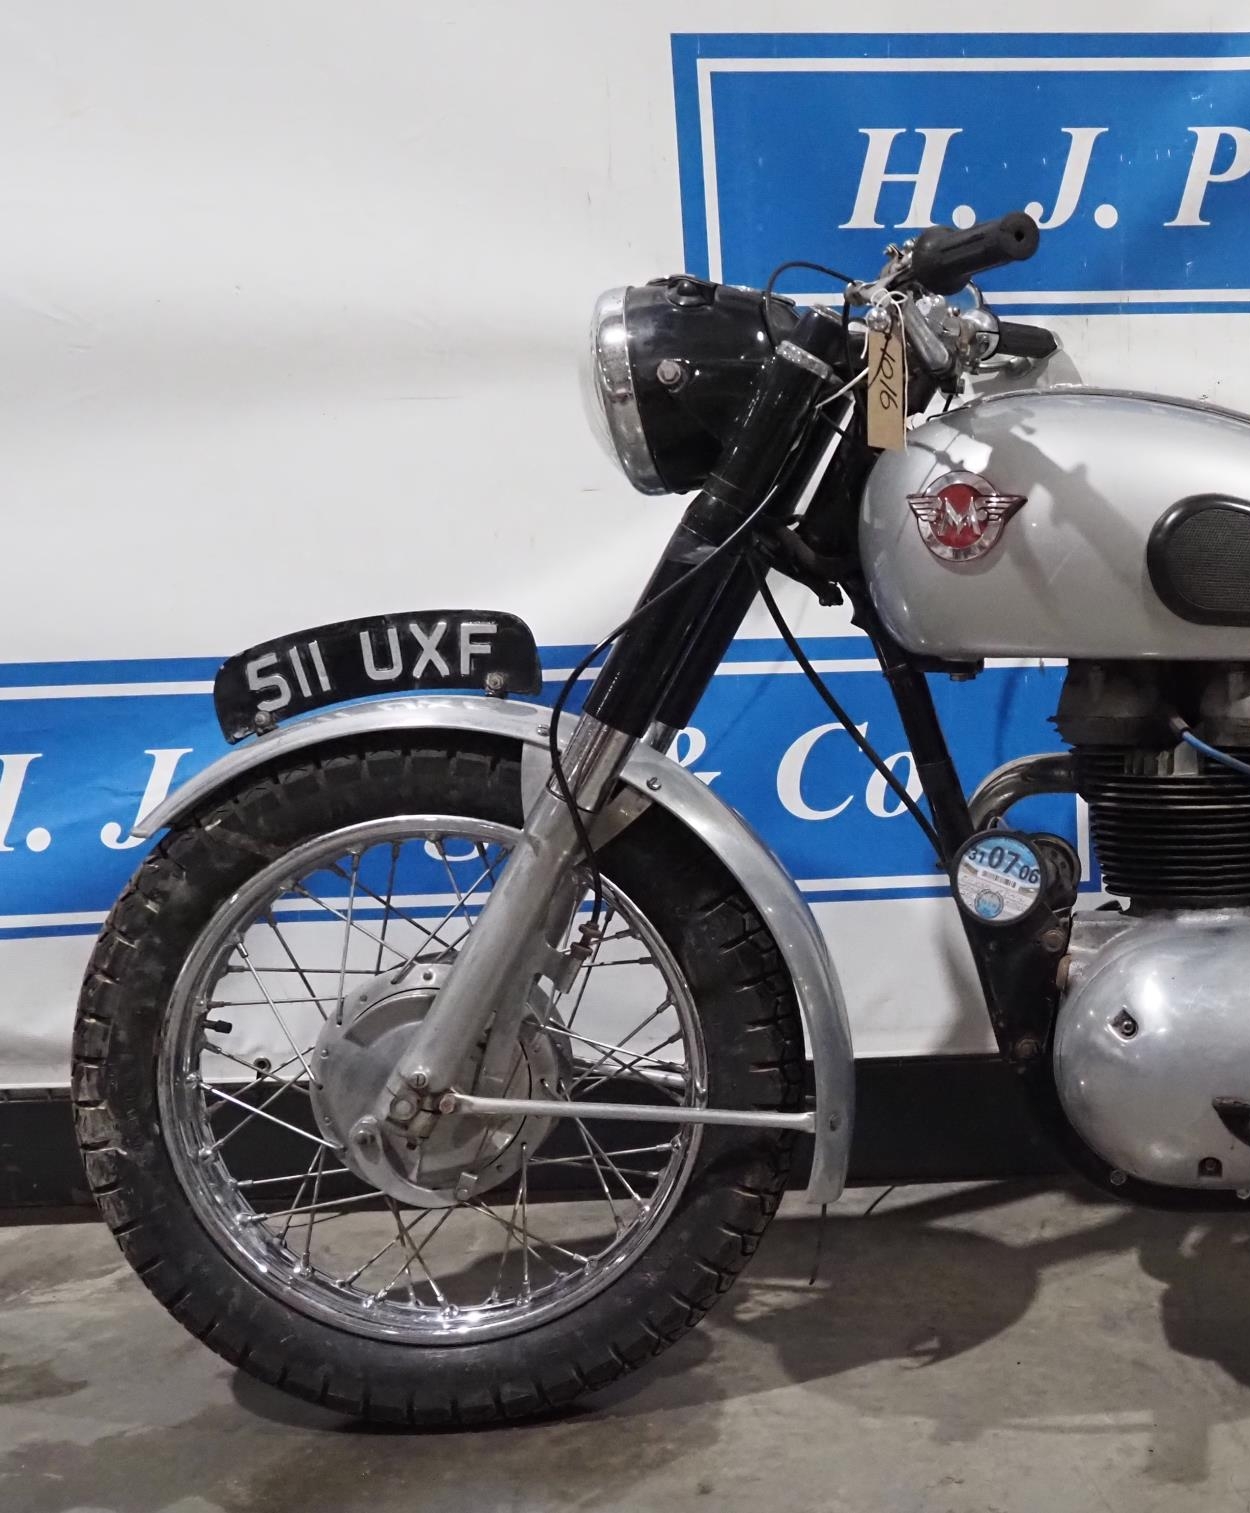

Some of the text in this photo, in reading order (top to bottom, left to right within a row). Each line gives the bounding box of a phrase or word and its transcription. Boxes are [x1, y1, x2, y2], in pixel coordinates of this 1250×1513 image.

[838, 128, 976, 229] H.
[1024, 127, 1118, 229] J.
[937, 496, 981, 537] M
[246, 621, 498, 713] 511 UXF
[776, 721, 924, 821] Co
[968, 846, 1040, 884] 31 07 06
